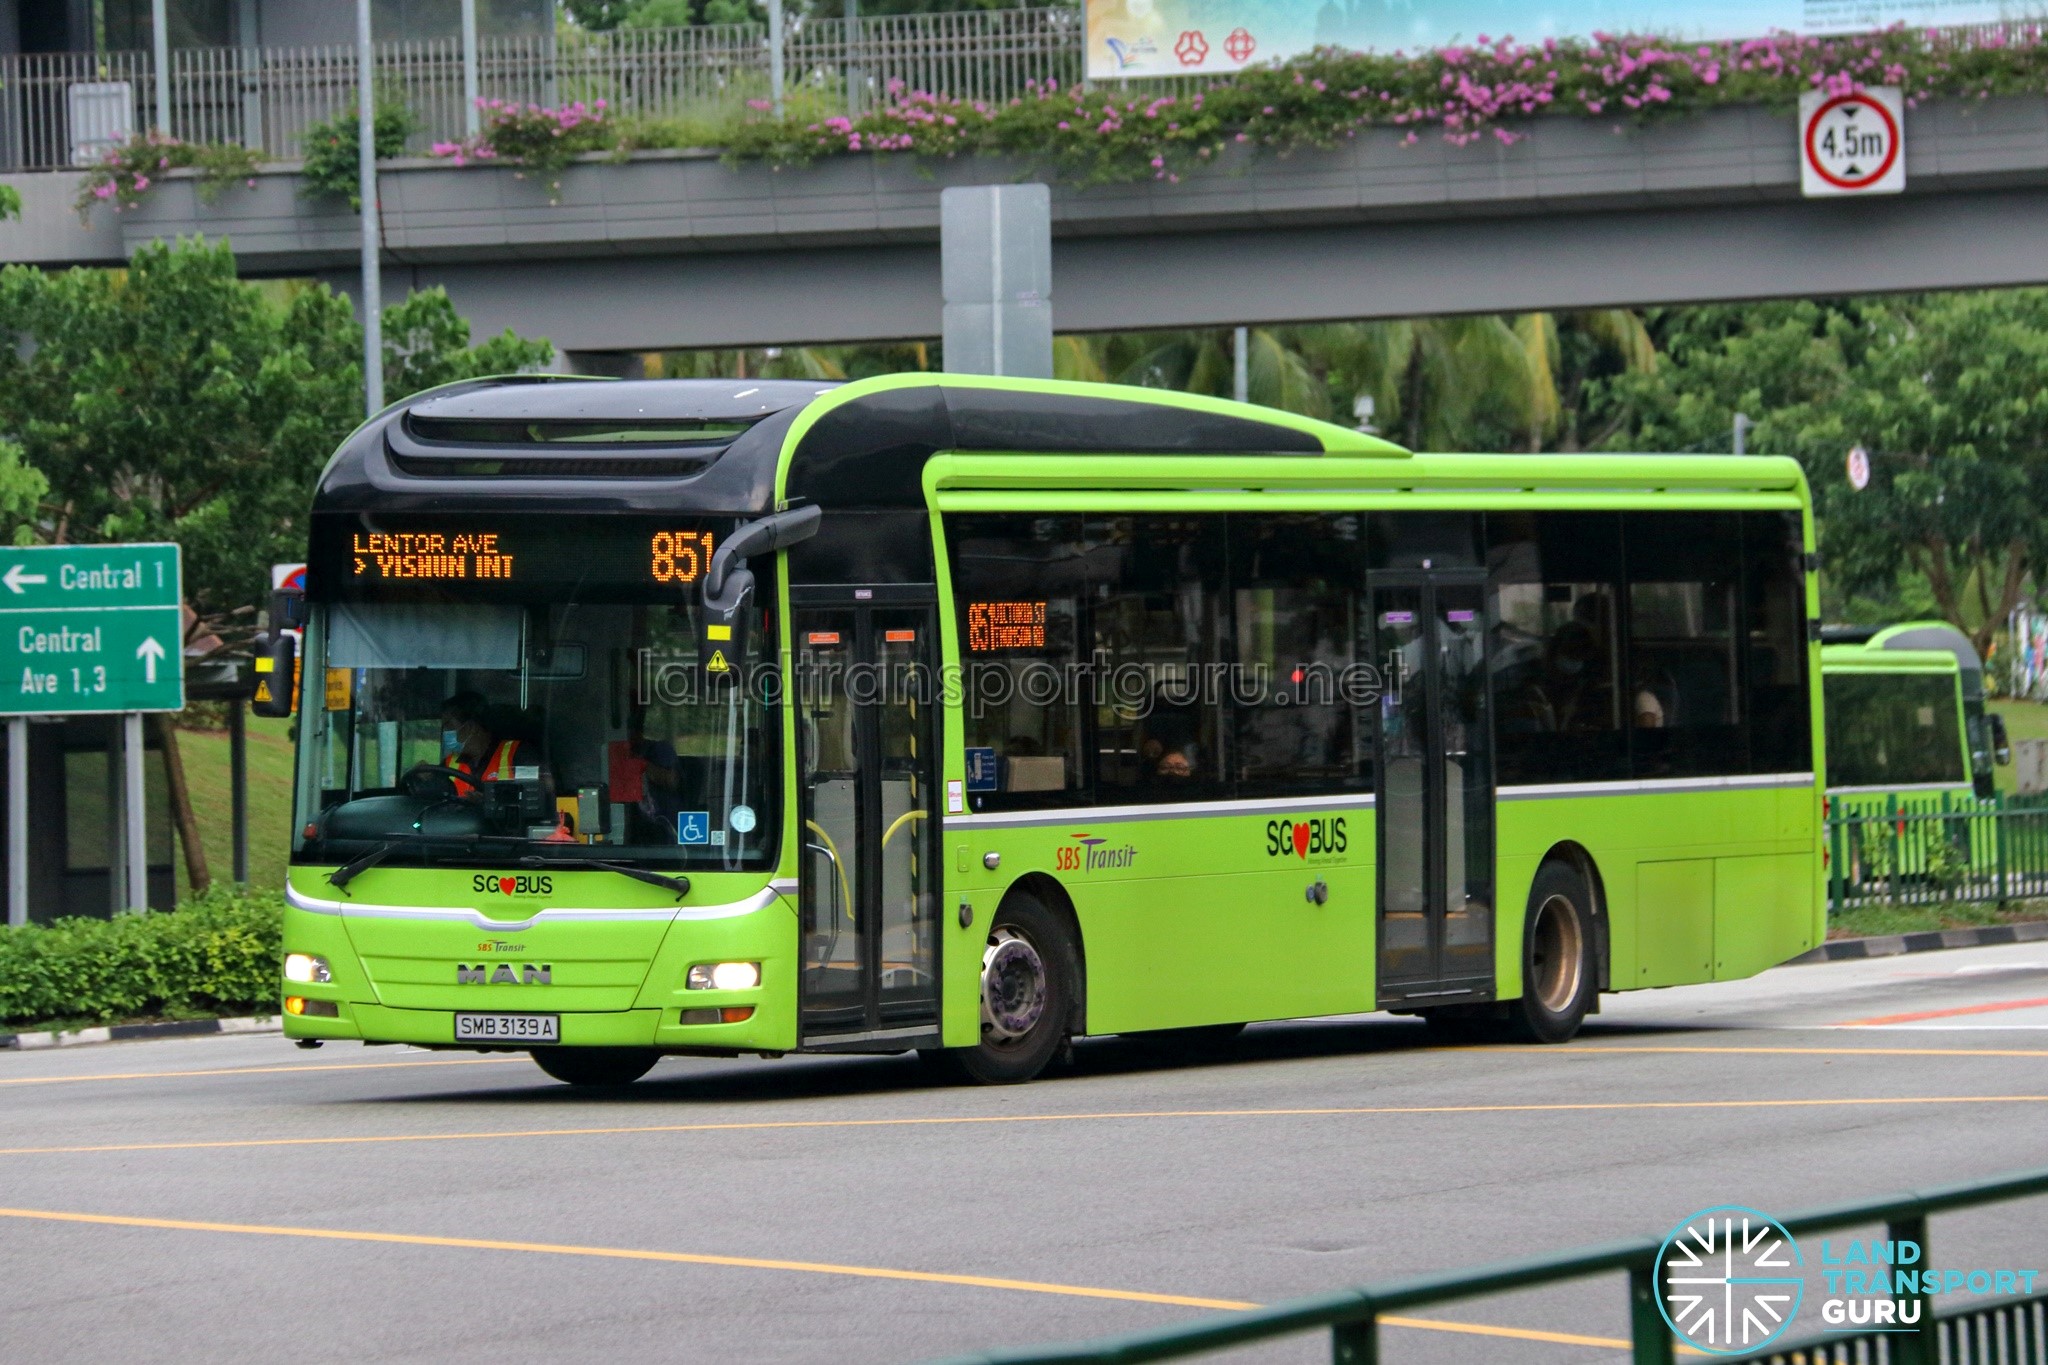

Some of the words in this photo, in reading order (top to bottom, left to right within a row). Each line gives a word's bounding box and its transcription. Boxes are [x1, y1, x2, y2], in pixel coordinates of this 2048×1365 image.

[1822, 126, 1883, 157] 4.5m
[353, 533, 445, 554] LENTOR
[453, 533, 498, 554] AVE
[651, 532, 713, 582] 851
[60, 561, 142, 590] Central
[154, 561, 164, 588] 1
[376, 555, 465, 578] YISHUN
[475, 555, 514, 578] INT
[19, 626, 102, 653] Central
[21, 667, 58, 694] Ave
[70, 665, 107, 696] 1,3
[1056, 846, 1081, 871] SBS
[1079, 838, 1138, 875] Transit
[477, 943, 492, 952] SBS
[493, 941, 527, 953] Transit
[458, 963, 553, 985] MAN
